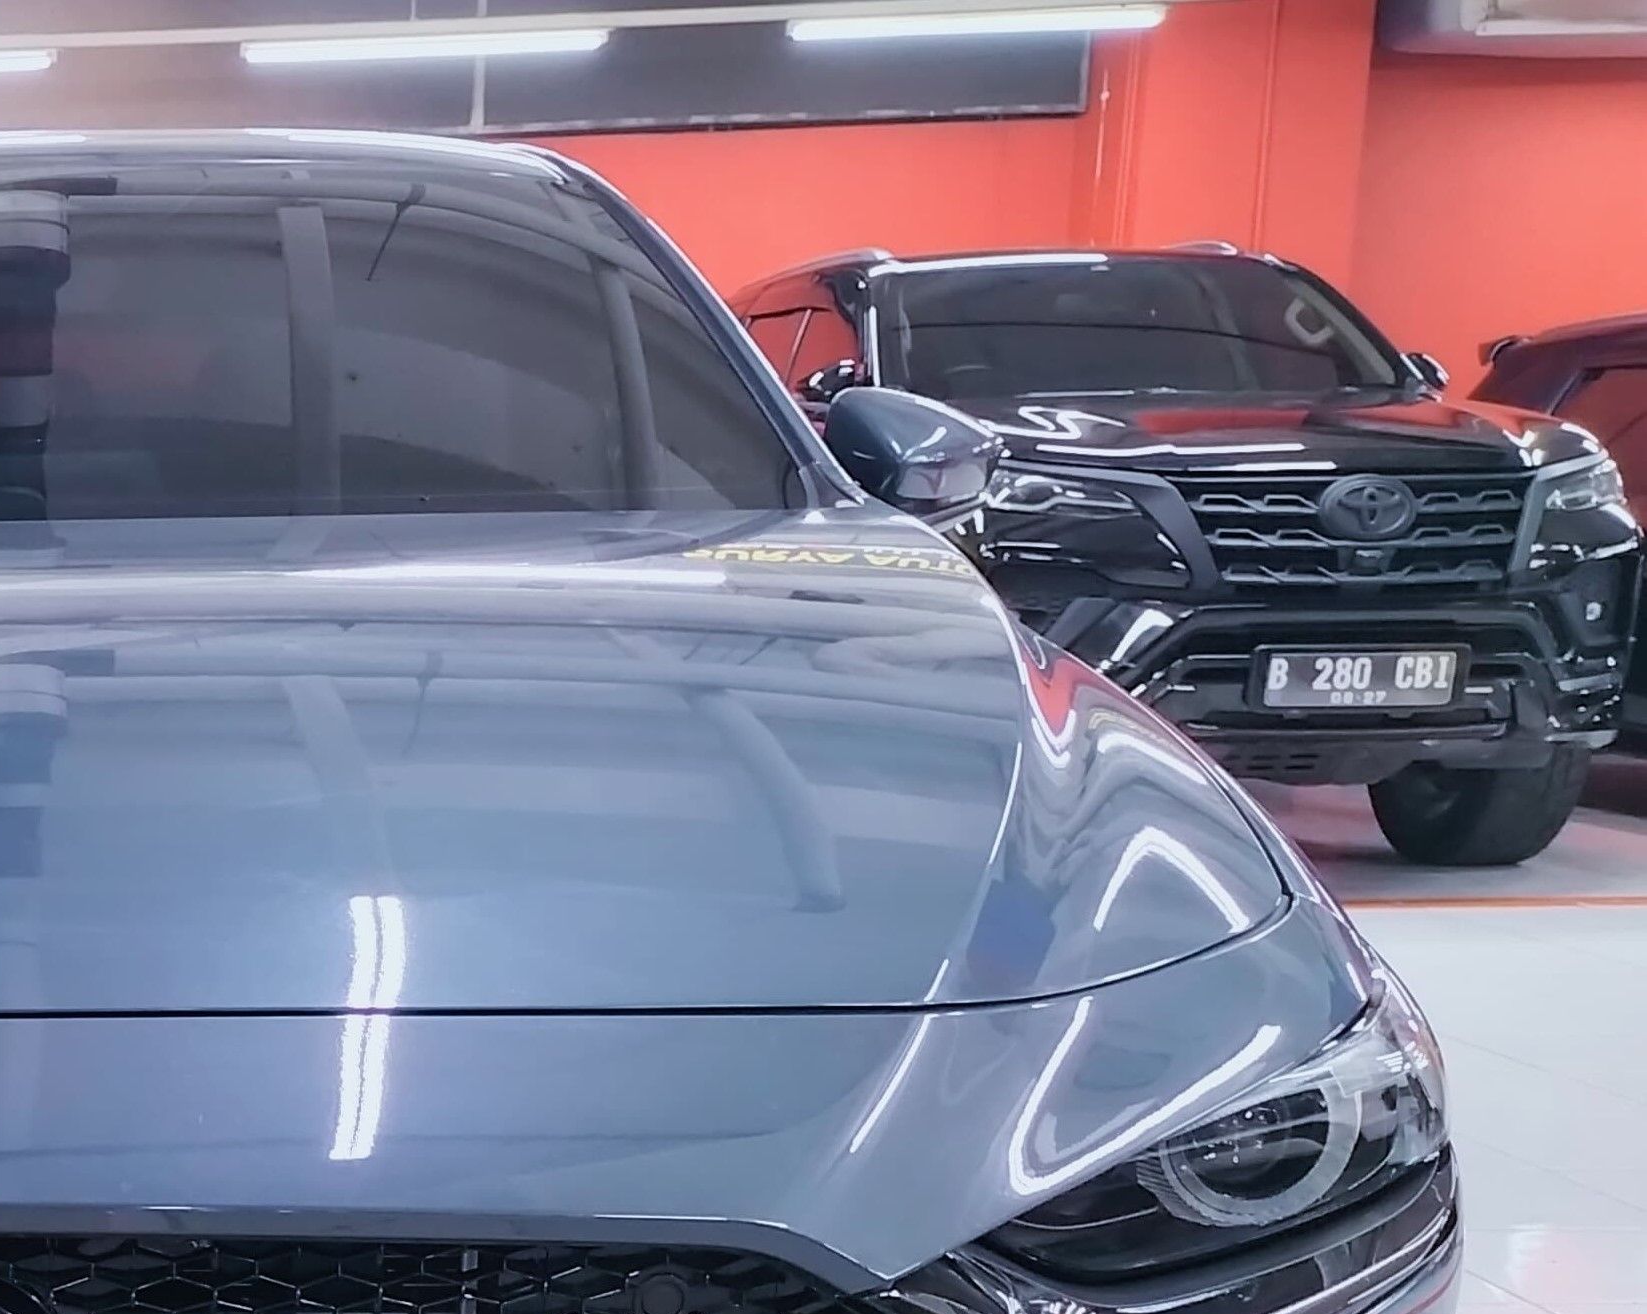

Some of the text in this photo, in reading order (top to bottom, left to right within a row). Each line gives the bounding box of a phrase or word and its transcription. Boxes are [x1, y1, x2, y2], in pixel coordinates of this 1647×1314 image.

[1267, 656, 1450, 690] B 280 CBI
